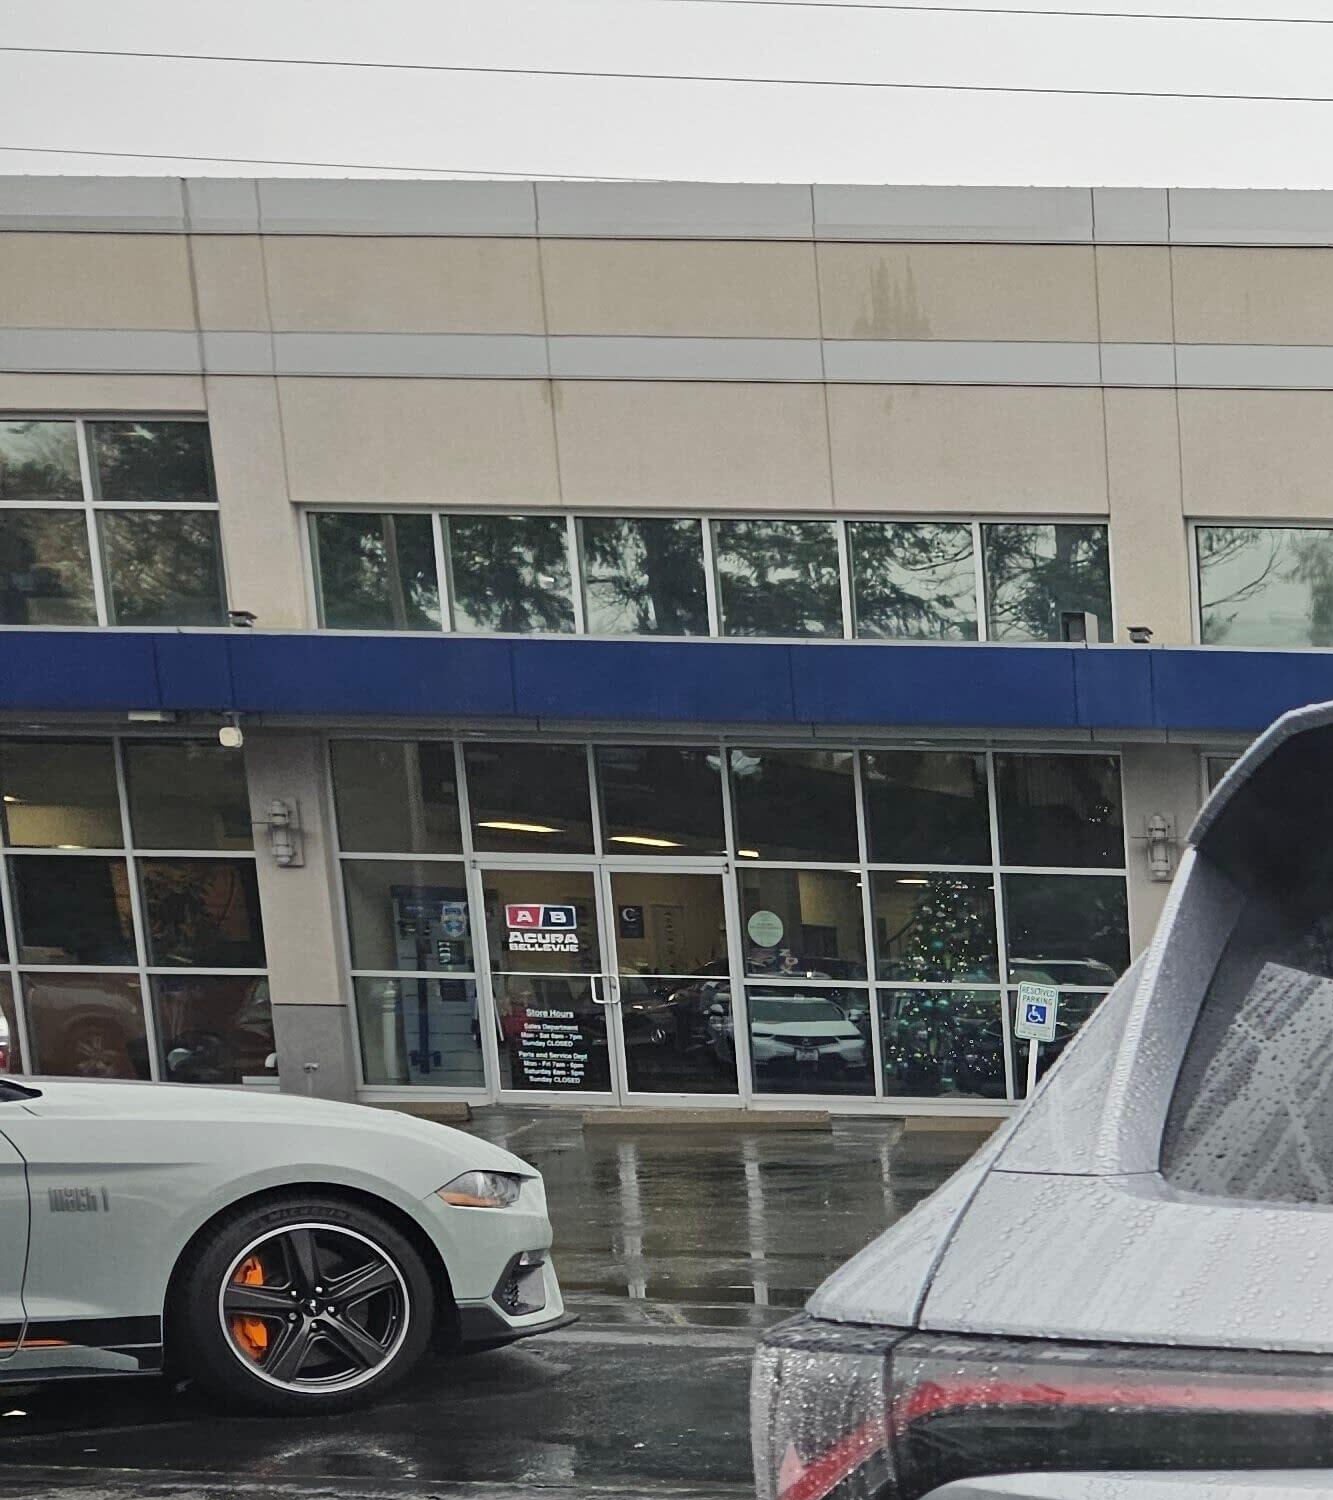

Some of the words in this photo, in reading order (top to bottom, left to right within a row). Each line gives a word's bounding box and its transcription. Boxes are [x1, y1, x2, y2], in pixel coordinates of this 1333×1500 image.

[516, 911, 533, 923] A
[549, 911, 567, 923] B
[509, 932, 579, 944] ACURA
[509, 943, 579, 952] BELLEVUE
[1023, 995, 1053, 1006] PARKING
[526, 1008, 548, 1018] Store
[550, 1009, 574, 1019] Hours
[542, 1024, 578, 1032] Department
[528, 1076, 552, 1085] Sunday
[553, 1076, 580, 1084] CLOSED
